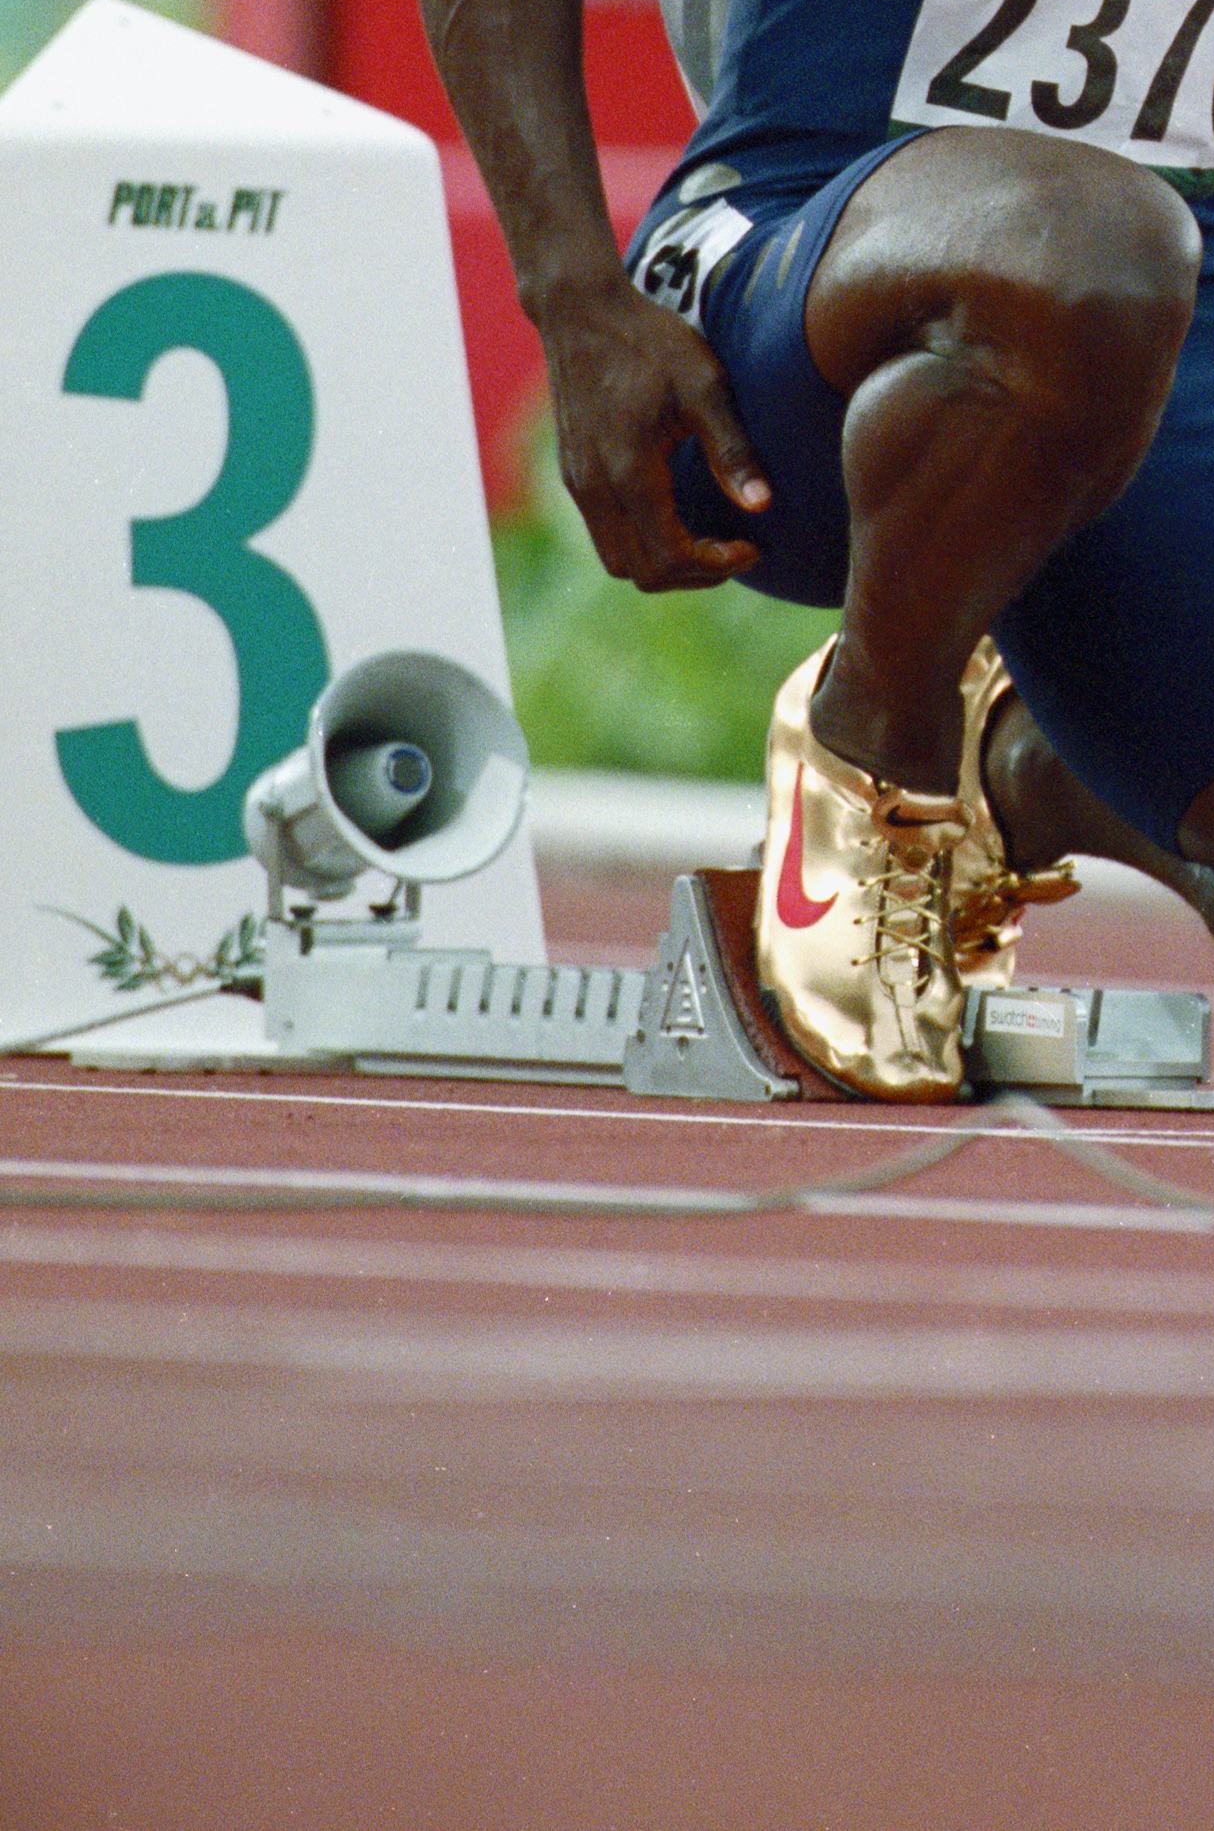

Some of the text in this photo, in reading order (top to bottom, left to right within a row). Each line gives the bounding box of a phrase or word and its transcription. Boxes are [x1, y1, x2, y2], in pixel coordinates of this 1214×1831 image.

[108, 180, 194, 229] PORT
[226, 187, 288, 235] PIT
[54, 270, 333, 866] 3
